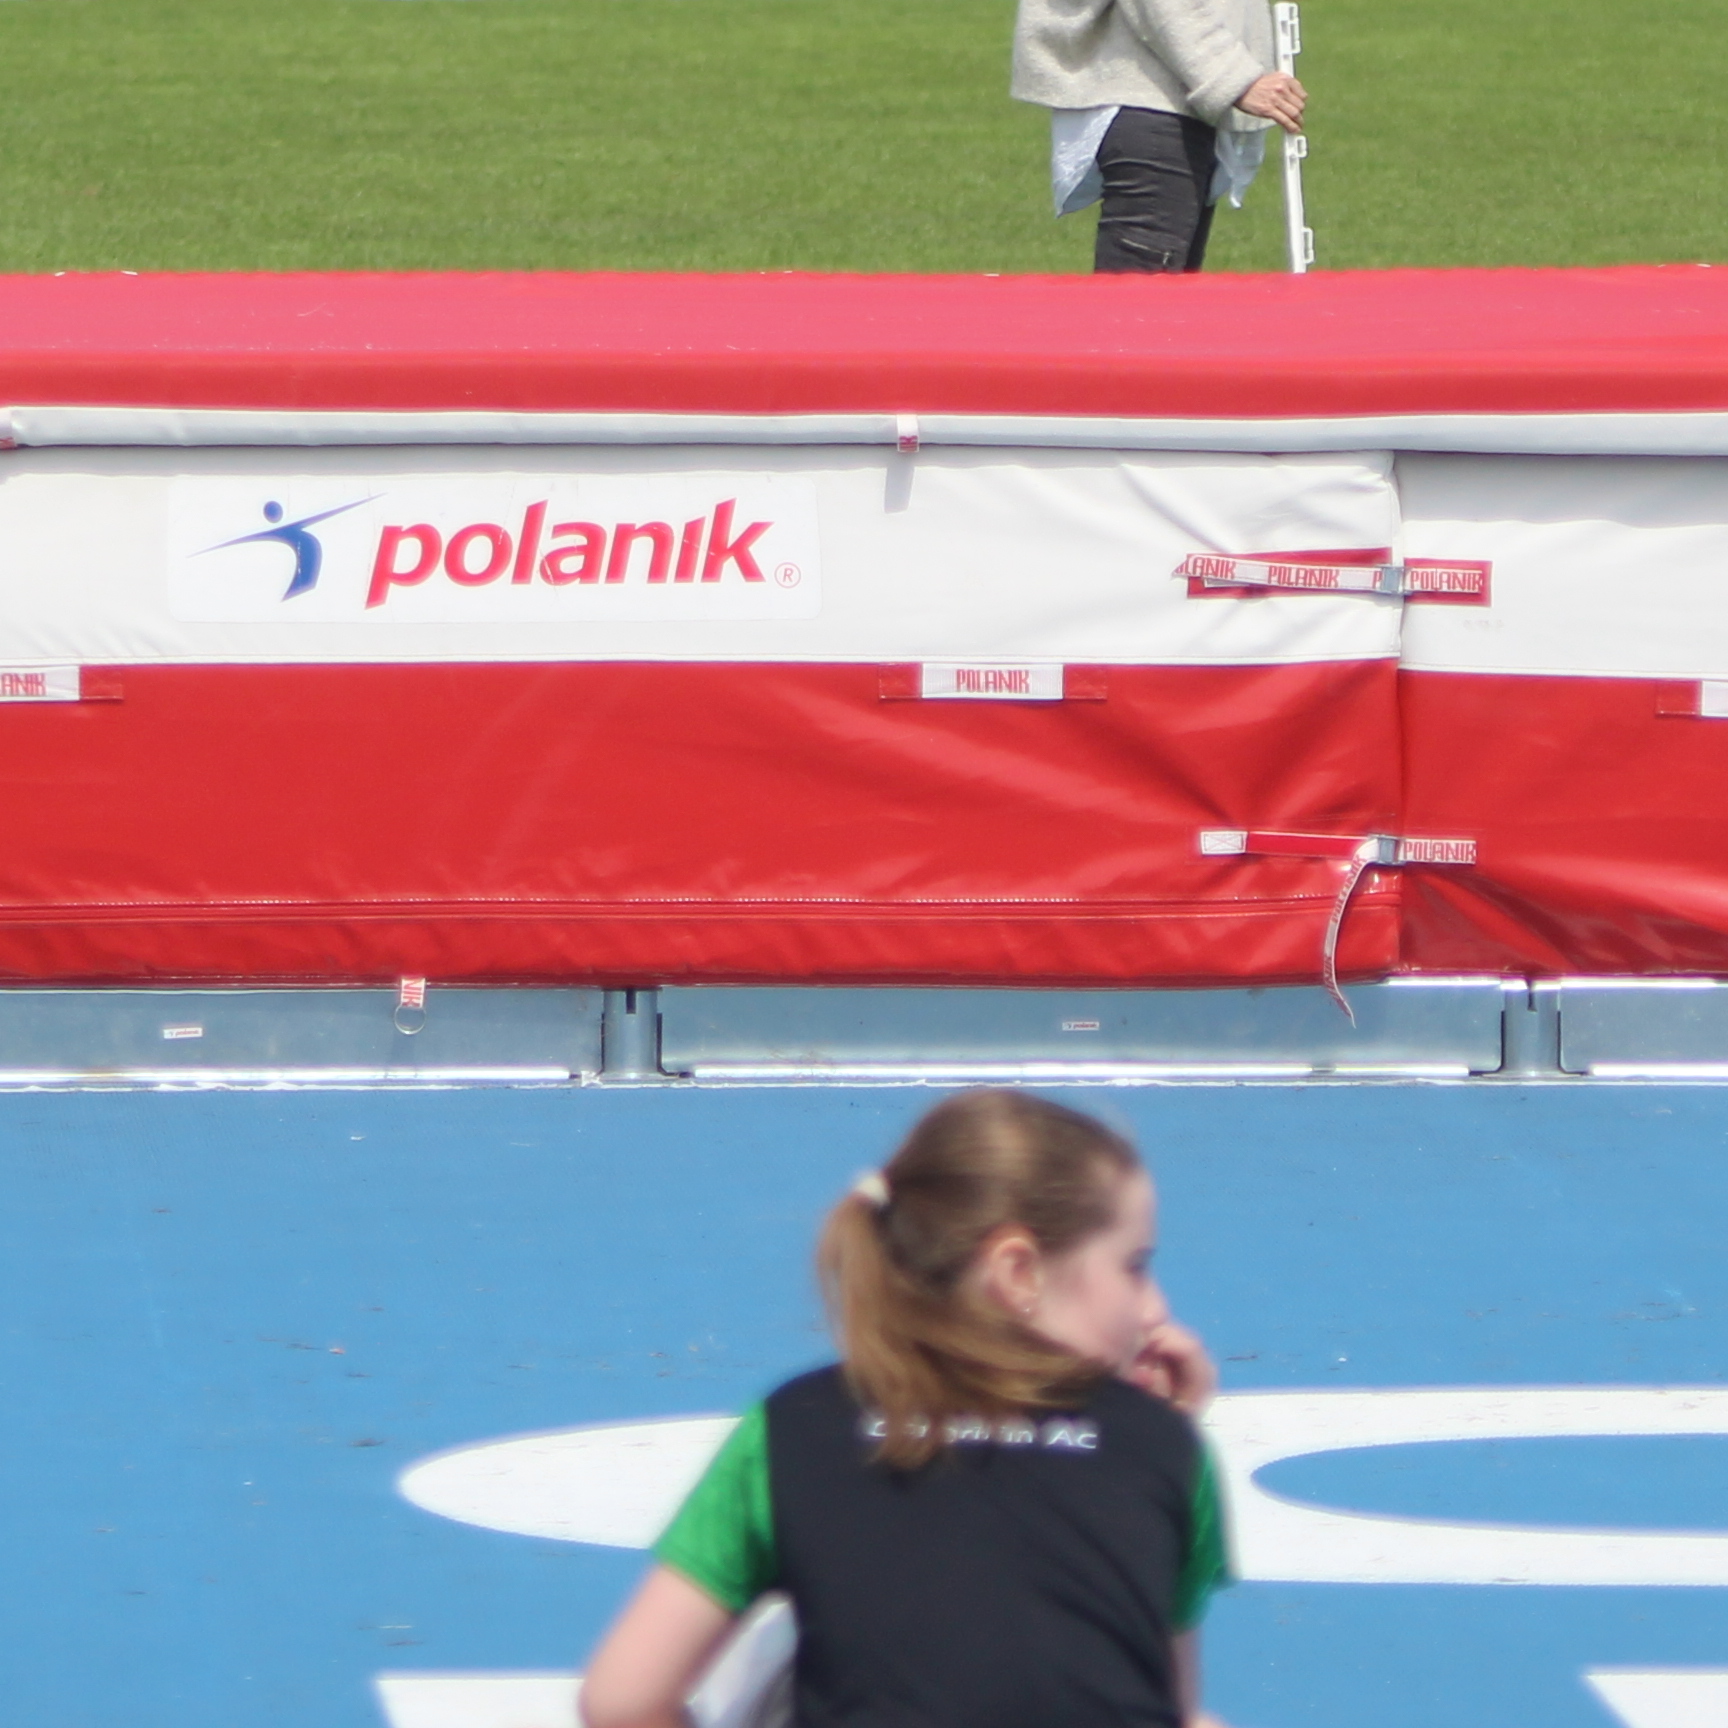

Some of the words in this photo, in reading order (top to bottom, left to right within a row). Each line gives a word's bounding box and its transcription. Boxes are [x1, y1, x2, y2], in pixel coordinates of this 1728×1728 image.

[364, 497, 774, 610] polanik
[1266, 565, 1340, 588] POLANIK
[1409, 570, 1483, 594] POLANIK
[956, 668, 1029, 694] POLANIK
[1403, 841, 1476, 863] POLANIK
